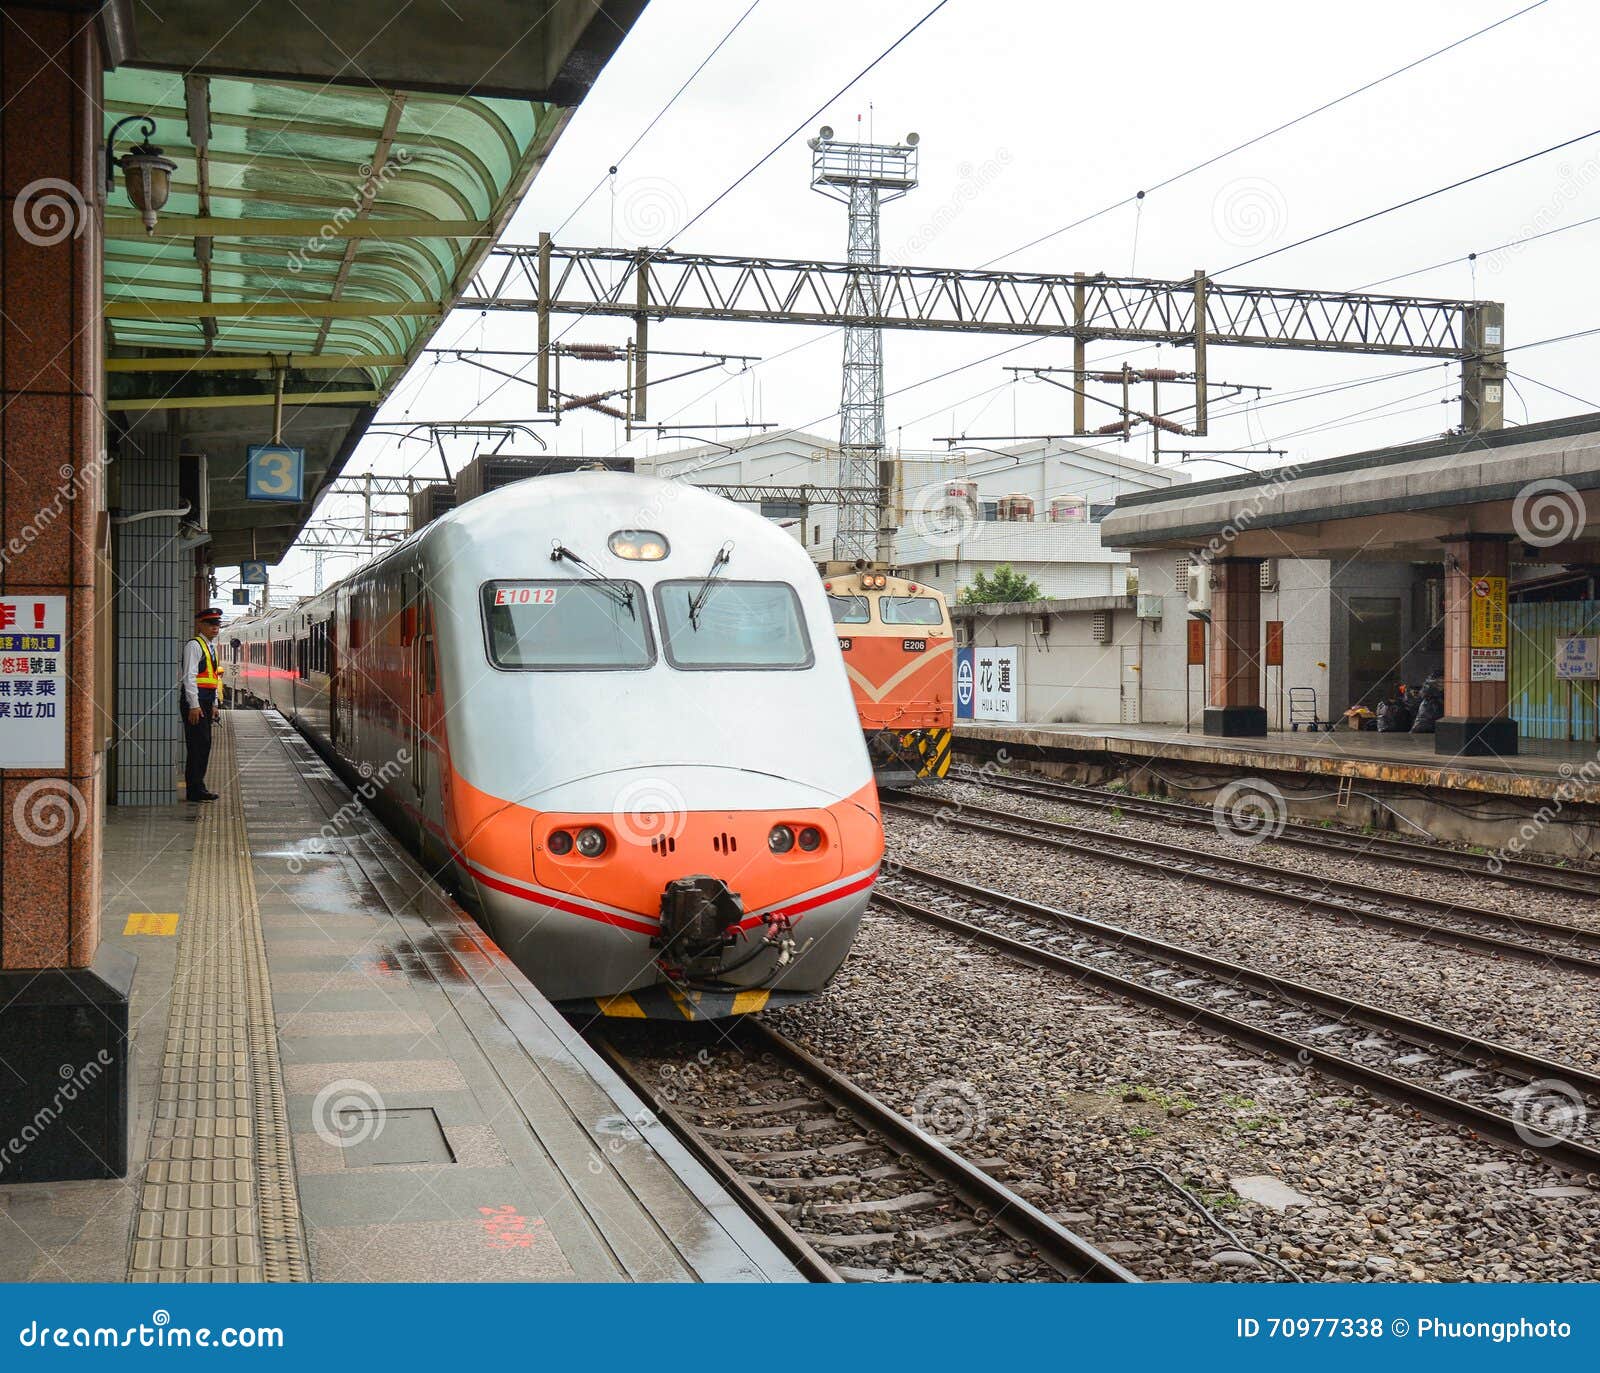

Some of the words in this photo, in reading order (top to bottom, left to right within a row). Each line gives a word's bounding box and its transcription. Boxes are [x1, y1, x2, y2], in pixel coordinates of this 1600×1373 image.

[257, 453, 293, 494] 3
[246, 564, 264, 581] 2
[495, 588, 555, 604] E1012
[904, 641, 925, 650] E206
[0, 657, 56, 674] 悠瑪號車
[980, 658, 1011, 692] 花蓮
